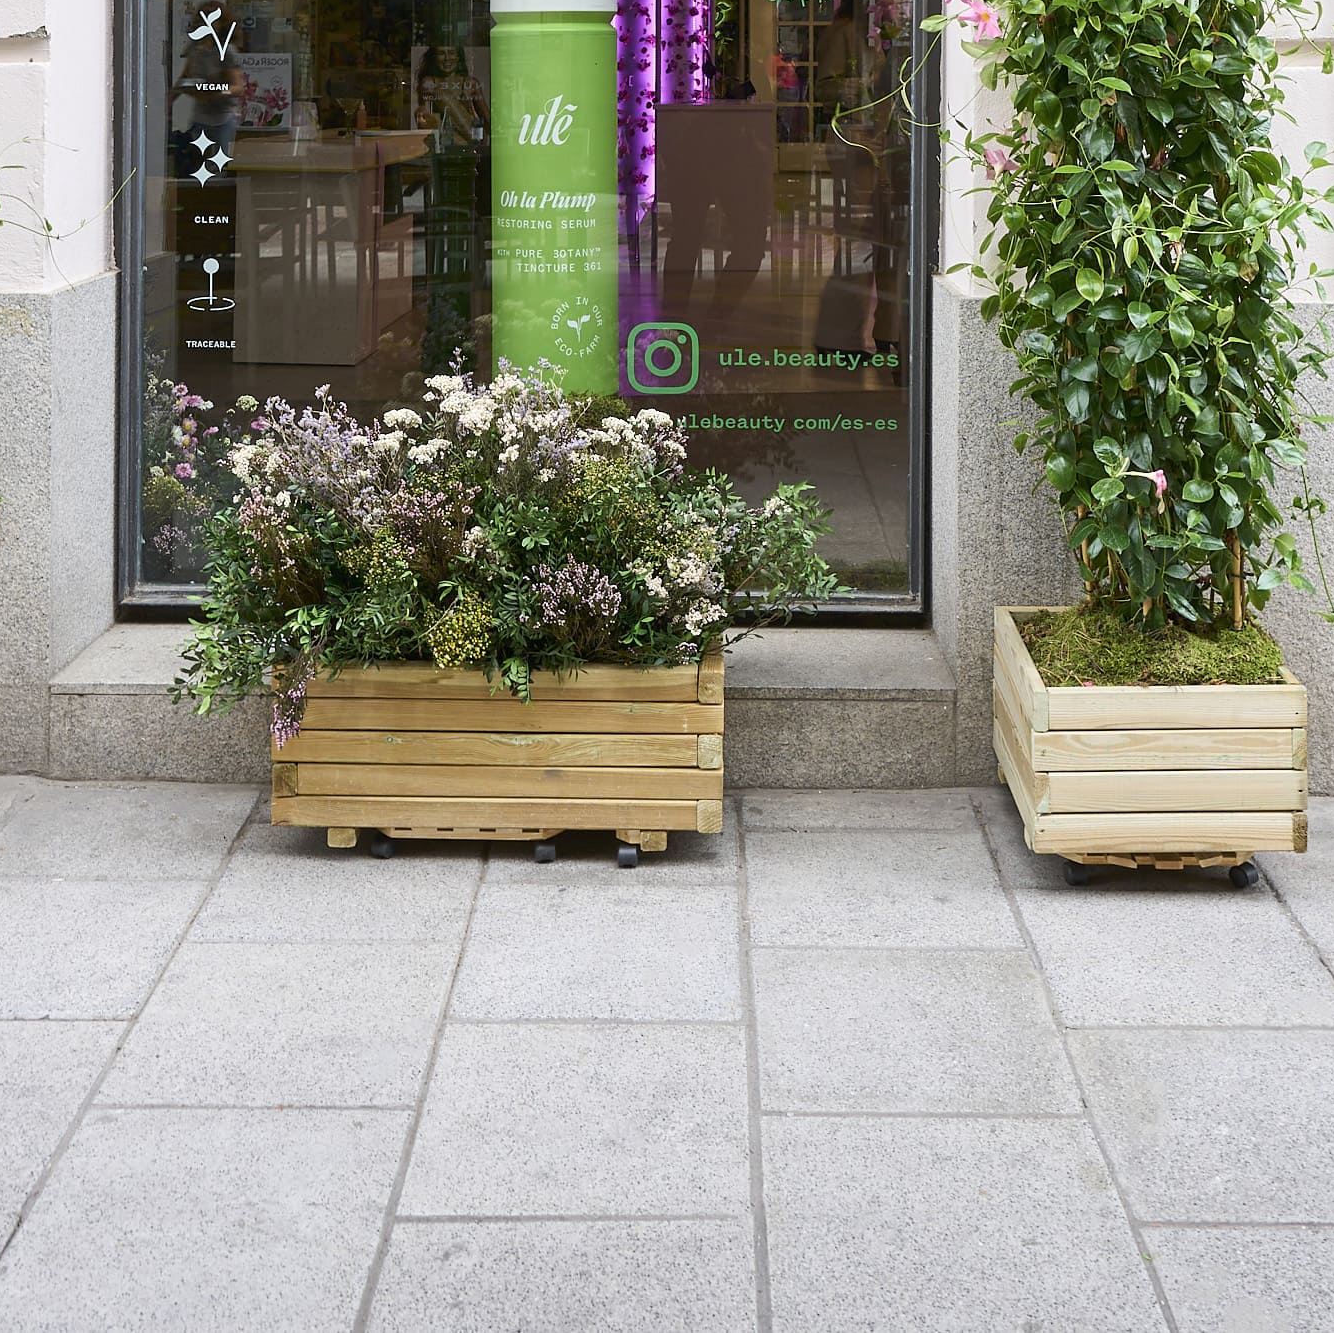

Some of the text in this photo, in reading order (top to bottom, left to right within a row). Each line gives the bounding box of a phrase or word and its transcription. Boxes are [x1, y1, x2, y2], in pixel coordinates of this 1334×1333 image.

[195, 83, 229, 91] VEGAN
[500, 190, 596, 213] Oh la Plump
[194, 215, 229, 224] CLEAN
[496, 217, 596, 229] RESTORING SERUM
[515, 248, 543, 259] PURE
[517, 262, 602, 273] TINCTURE 361
[550, 296, 603, 330] BORN IN OUR
[186, 340, 236, 349] TRACEABLE
[554, 334, 601, 358] ECO-FARM
[719, 348, 899, 371] ule.beauty.es
